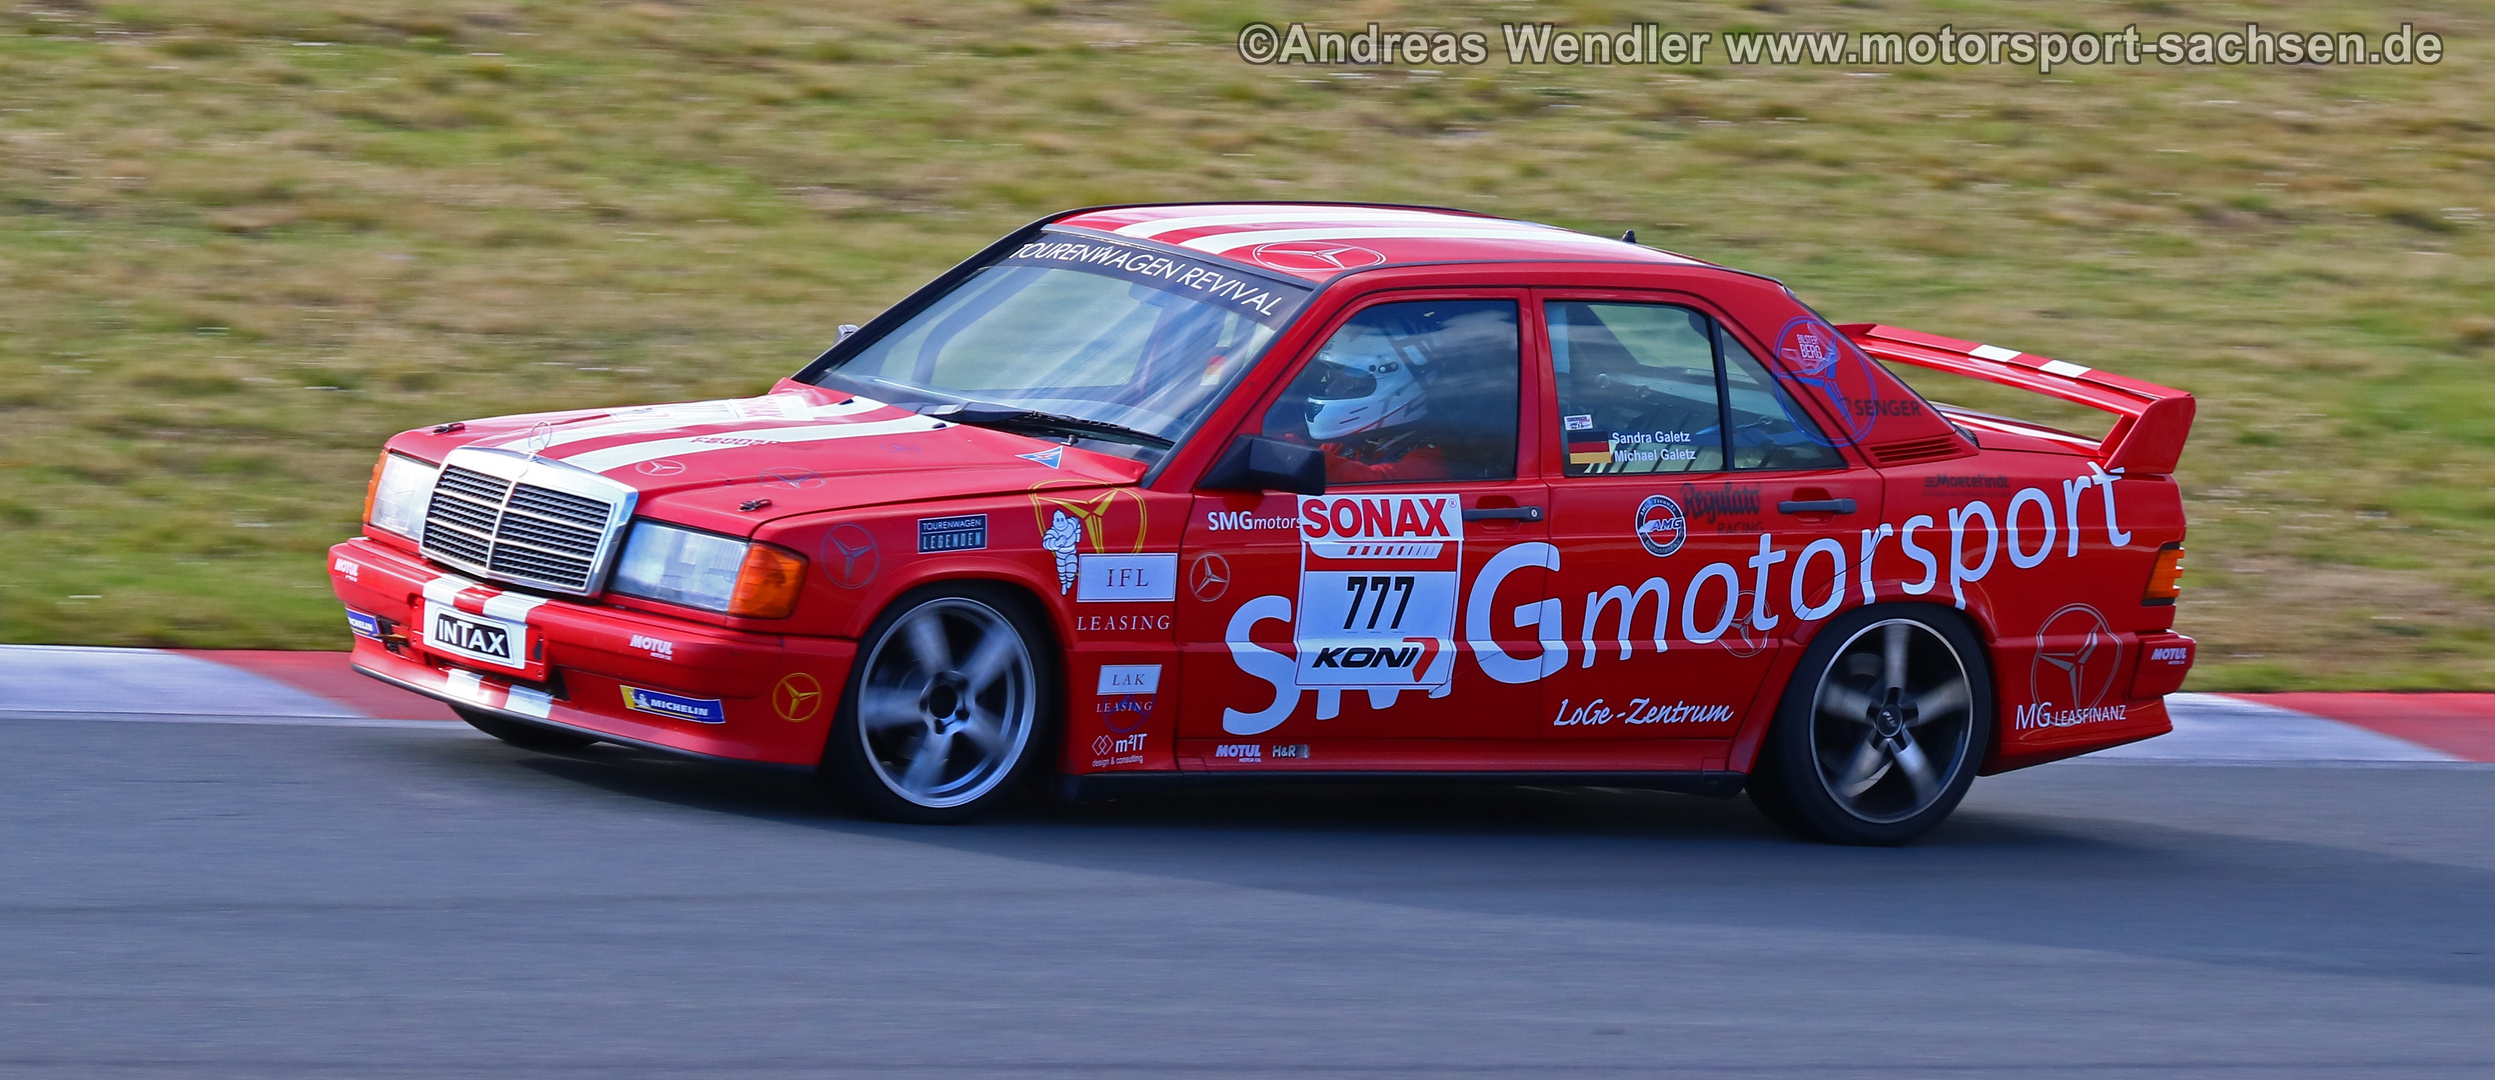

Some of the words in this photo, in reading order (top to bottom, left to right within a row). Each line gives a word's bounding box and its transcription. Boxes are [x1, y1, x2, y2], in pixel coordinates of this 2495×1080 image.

[1009, 242, 1181, 279] TOURENWAGEN
[1177, 266, 1283, 317] REVIVAL
[1800, 344, 1823, 359] BERG
[1855, 399, 1921, 416] SENGER
[1612, 432, 1652, 444] Sandra
[1655, 431, 1691, 443] Galetz
[1614, 449, 1657, 462] Michael
[1660, 448, 1696, 461] Galetz
[923, 519, 981, 531] TOURENWAGEN
[1208, 511, 1301, 530] SMGmotors
[1302, 498, 1451, 538] SONAX
[1651, 518, 1682, 530] AMG
[1717, 522, 1764, 533] RACING
[923, 533, 981, 550] LEGENDEN
[334, 558, 359, 577] MOTUL
[1106, 568, 1150, 588] IFL
[1343, 576, 1415, 630] 777
[348, 617, 373, 632] CHELIN
[1076, 614, 1171, 631] LEASING
[438, 619, 507, 657] INTAX
[629, 634, 673, 655] MOTUL
[1312, 647, 1420, 669] KONI
[2151, 647, 2187, 660] MOTUL
[1112, 673, 1145, 686] LAK
[650, 698, 709, 716] MICHELIN
[1096, 701, 1153, 713] LEASING
[2015, 702, 2052, 730] MG
[2054, 704, 2127, 726] LEASFINANZ
[1215, 744, 1261, 757] MOTUL
[1272, 745, 1296, 759] H&R
[1092, 758, 1110, 768] design
[1115, 754, 1143, 765] consulting
